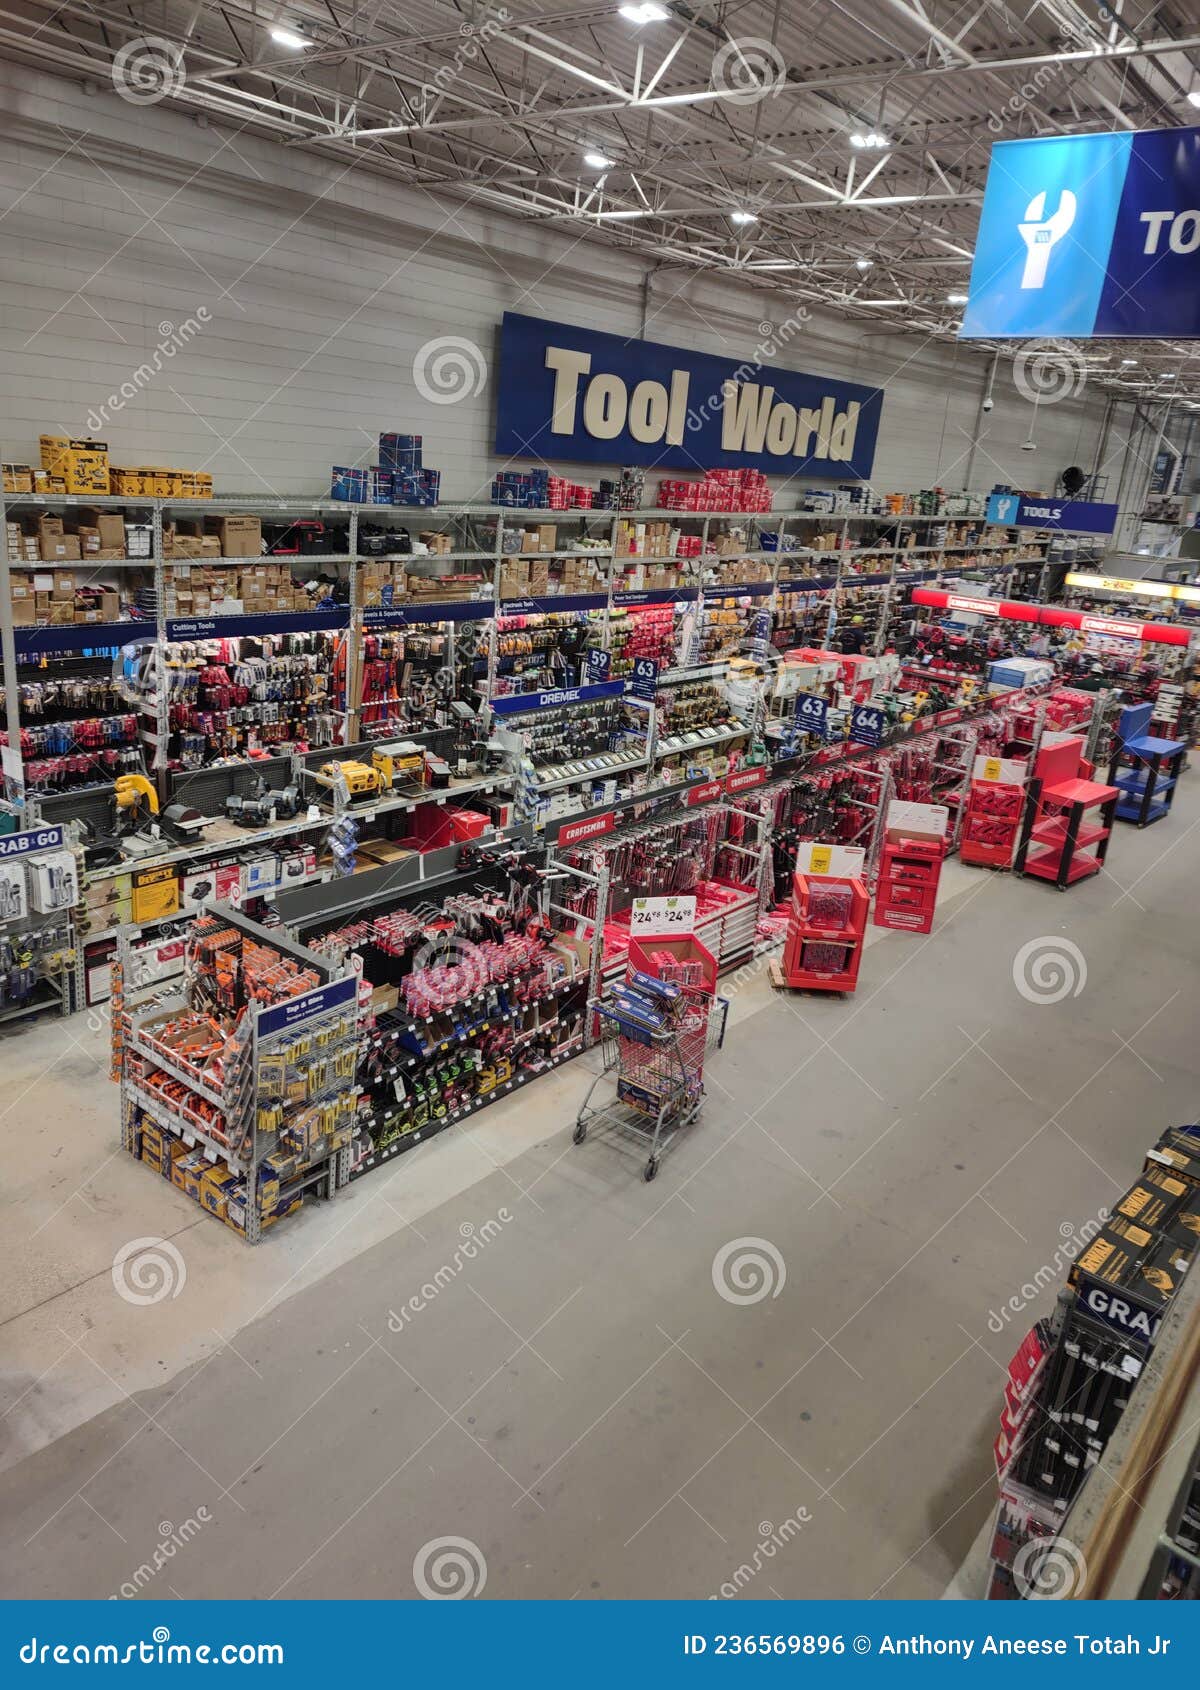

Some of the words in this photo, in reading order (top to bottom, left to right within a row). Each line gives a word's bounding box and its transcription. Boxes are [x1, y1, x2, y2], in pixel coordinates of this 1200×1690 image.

[1140, 209, 1200, 255] TO
[545, 346, 690, 446] Tool
[721, 379, 861, 462] World
[1023, 506, 1062, 520] TOOLS
[172, 623, 197, 632] Cutting
[198, 622, 216, 630] Tools
[591, 650, 608, 668] 59
[637, 660, 654, 678] 63
[540, 689, 581, 705] DREMEL
[802, 698, 824, 717] 63
[856, 710, 879, 730] 64
[37, 830, 59, 846] GO
[566, 820, 606, 840] CRAFTSMAN
